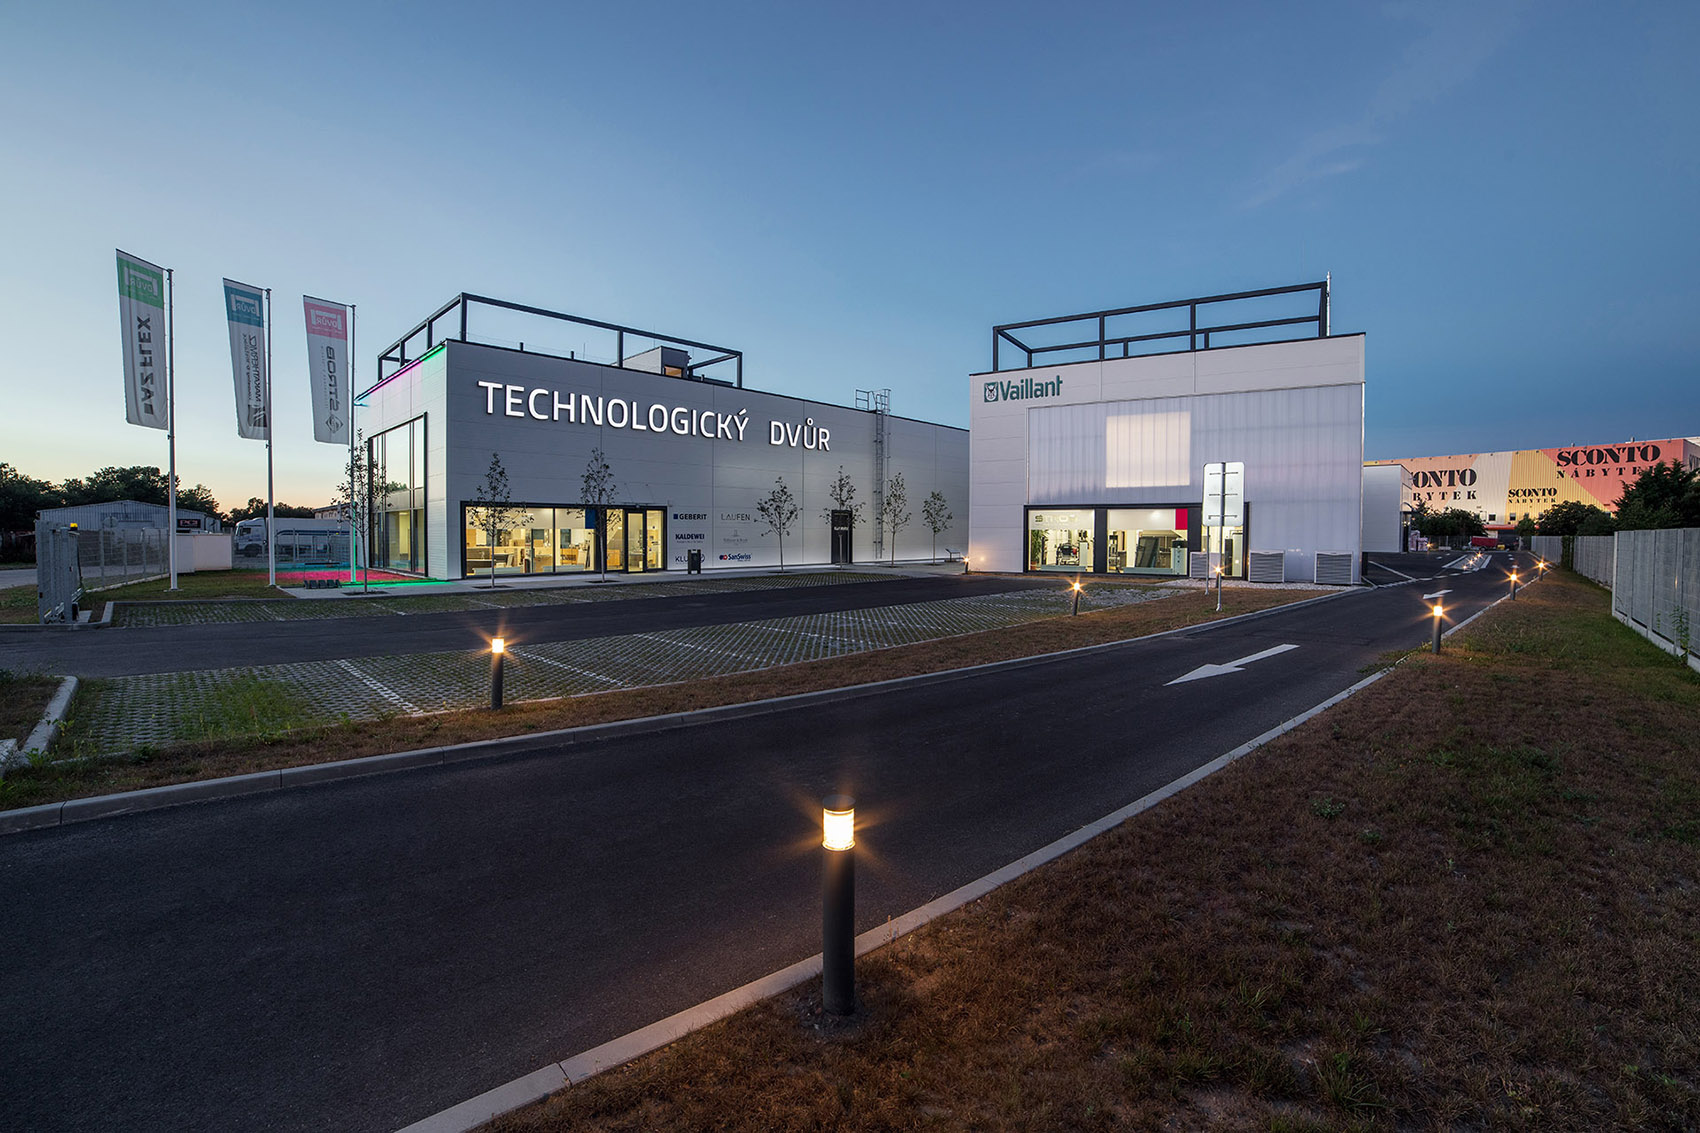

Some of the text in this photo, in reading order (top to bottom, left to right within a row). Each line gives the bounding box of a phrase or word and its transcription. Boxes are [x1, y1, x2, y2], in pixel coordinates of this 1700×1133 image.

[1000, 375, 1063, 401] Vaillant
[477, 380, 831, 451] TECHNOLOGICKÝ DVŮR
[1556, 444, 1661, 467] SCONTO
[1411, 468, 1477, 488] ONTO
[1413, 490, 1477, 501] BYTEK
[1508, 487, 1558, 498] SCONTO
[728, 552, 752, 560] SanSwiss
